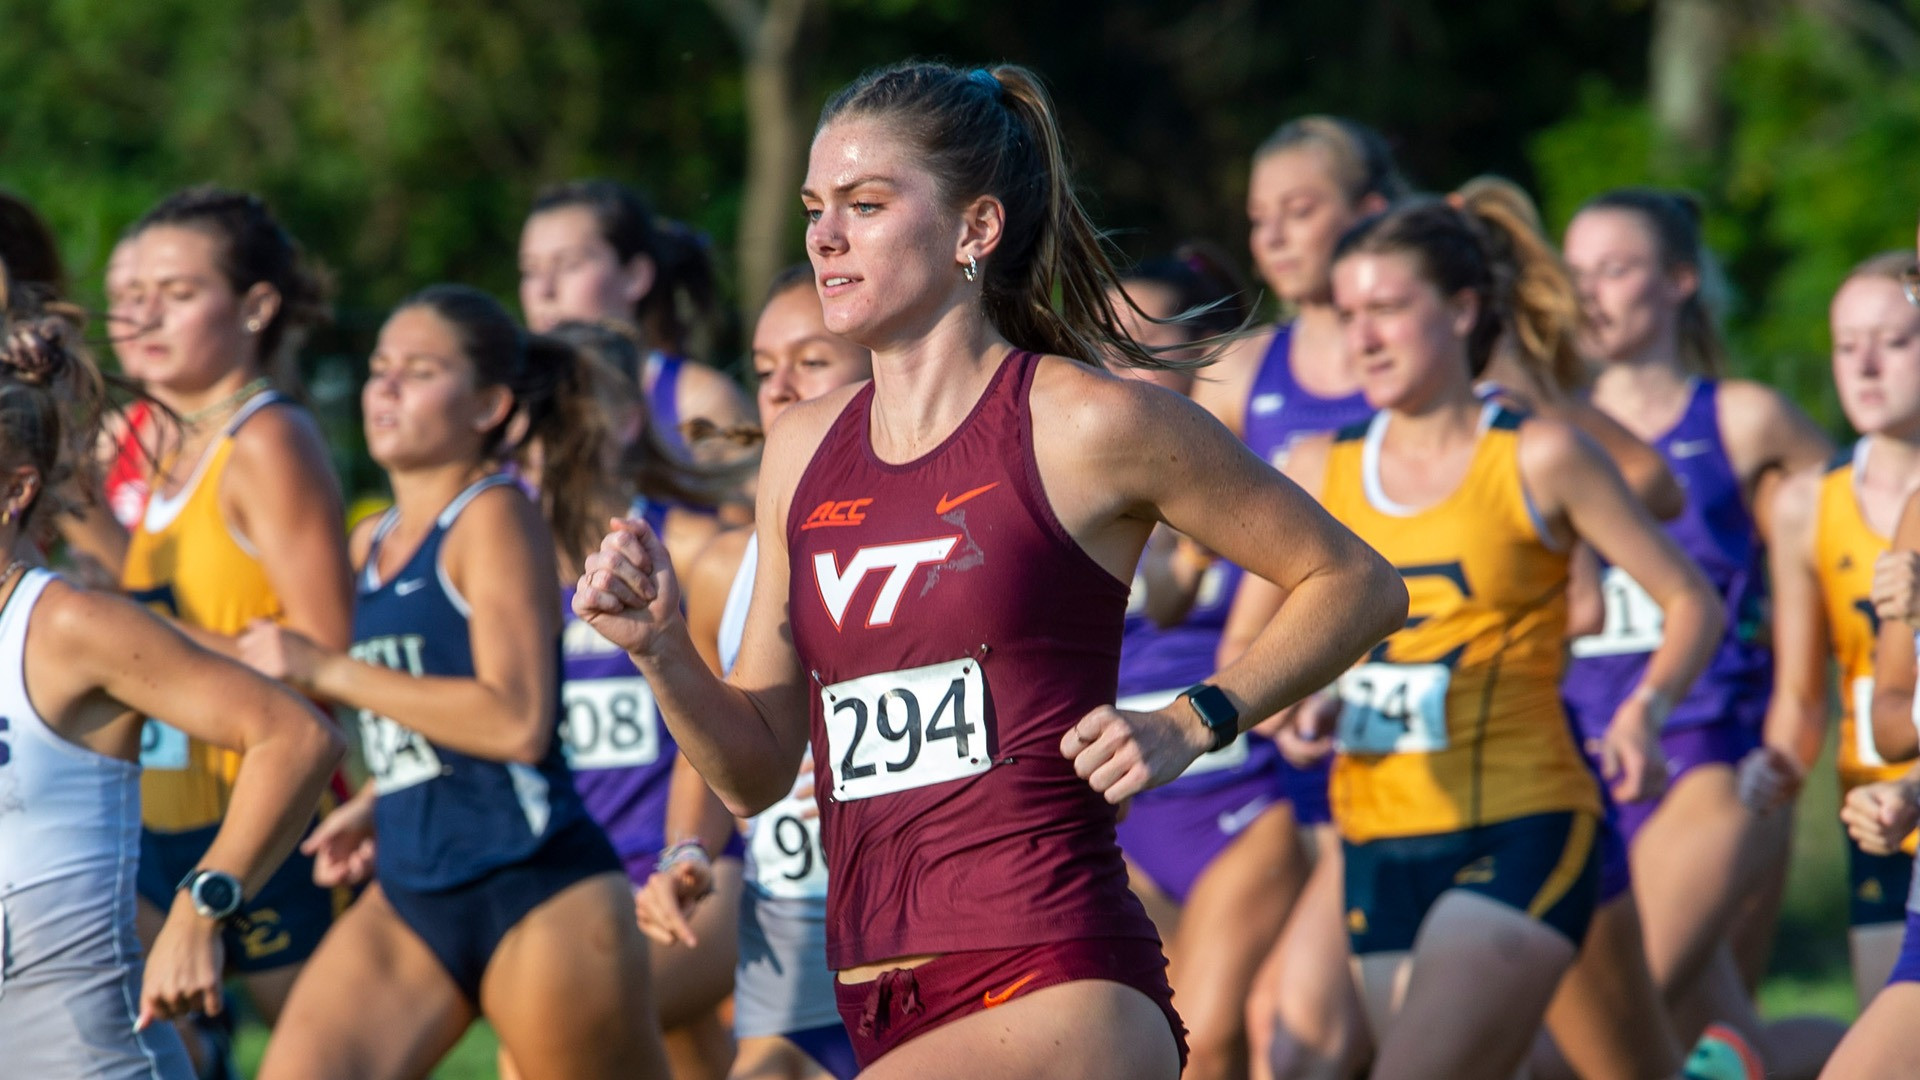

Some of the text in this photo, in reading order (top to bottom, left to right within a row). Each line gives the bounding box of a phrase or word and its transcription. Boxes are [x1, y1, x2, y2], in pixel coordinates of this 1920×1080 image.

[801, 498, 873, 530] ACC
[811, 534, 963, 633] VT
[833, 678, 975, 781] 294
[774, 815, 824, 880] 9
